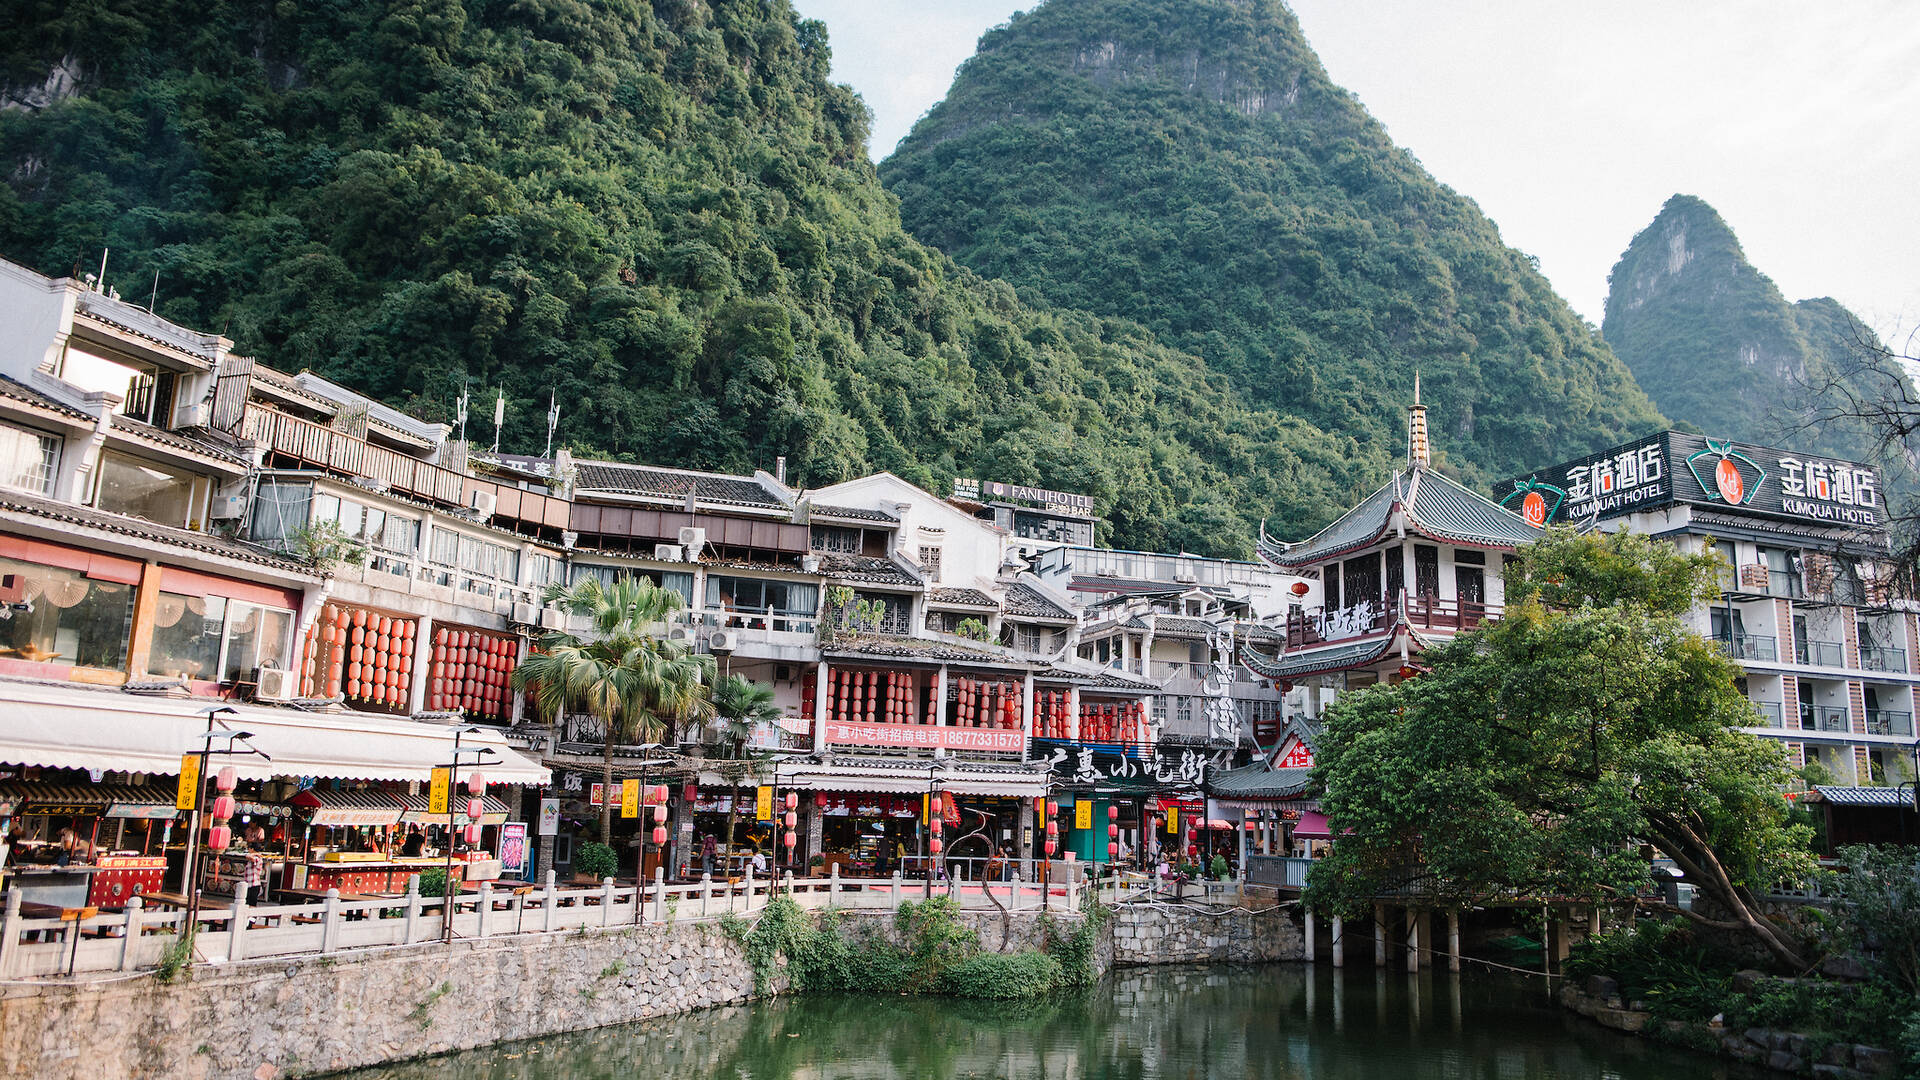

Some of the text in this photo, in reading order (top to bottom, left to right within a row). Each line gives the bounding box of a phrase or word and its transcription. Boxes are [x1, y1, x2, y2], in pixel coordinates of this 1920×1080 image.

[1566, 443, 1662, 504] 金桔酒店
[1778, 457, 1876, 508] 金桔酒店
[1048, 491, 1093, 508] HOTEL
[1072, 506, 1092, 517] BAR
[1569, 484, 1665, 519] KUMQUAT HOTEL
[1782, 499, 1878, 525] KUMQUAT HOTEL
[824, 725, 940, 744] 广惠小吃街招商电话
[942, 731, 1022, 748] 18677331573
